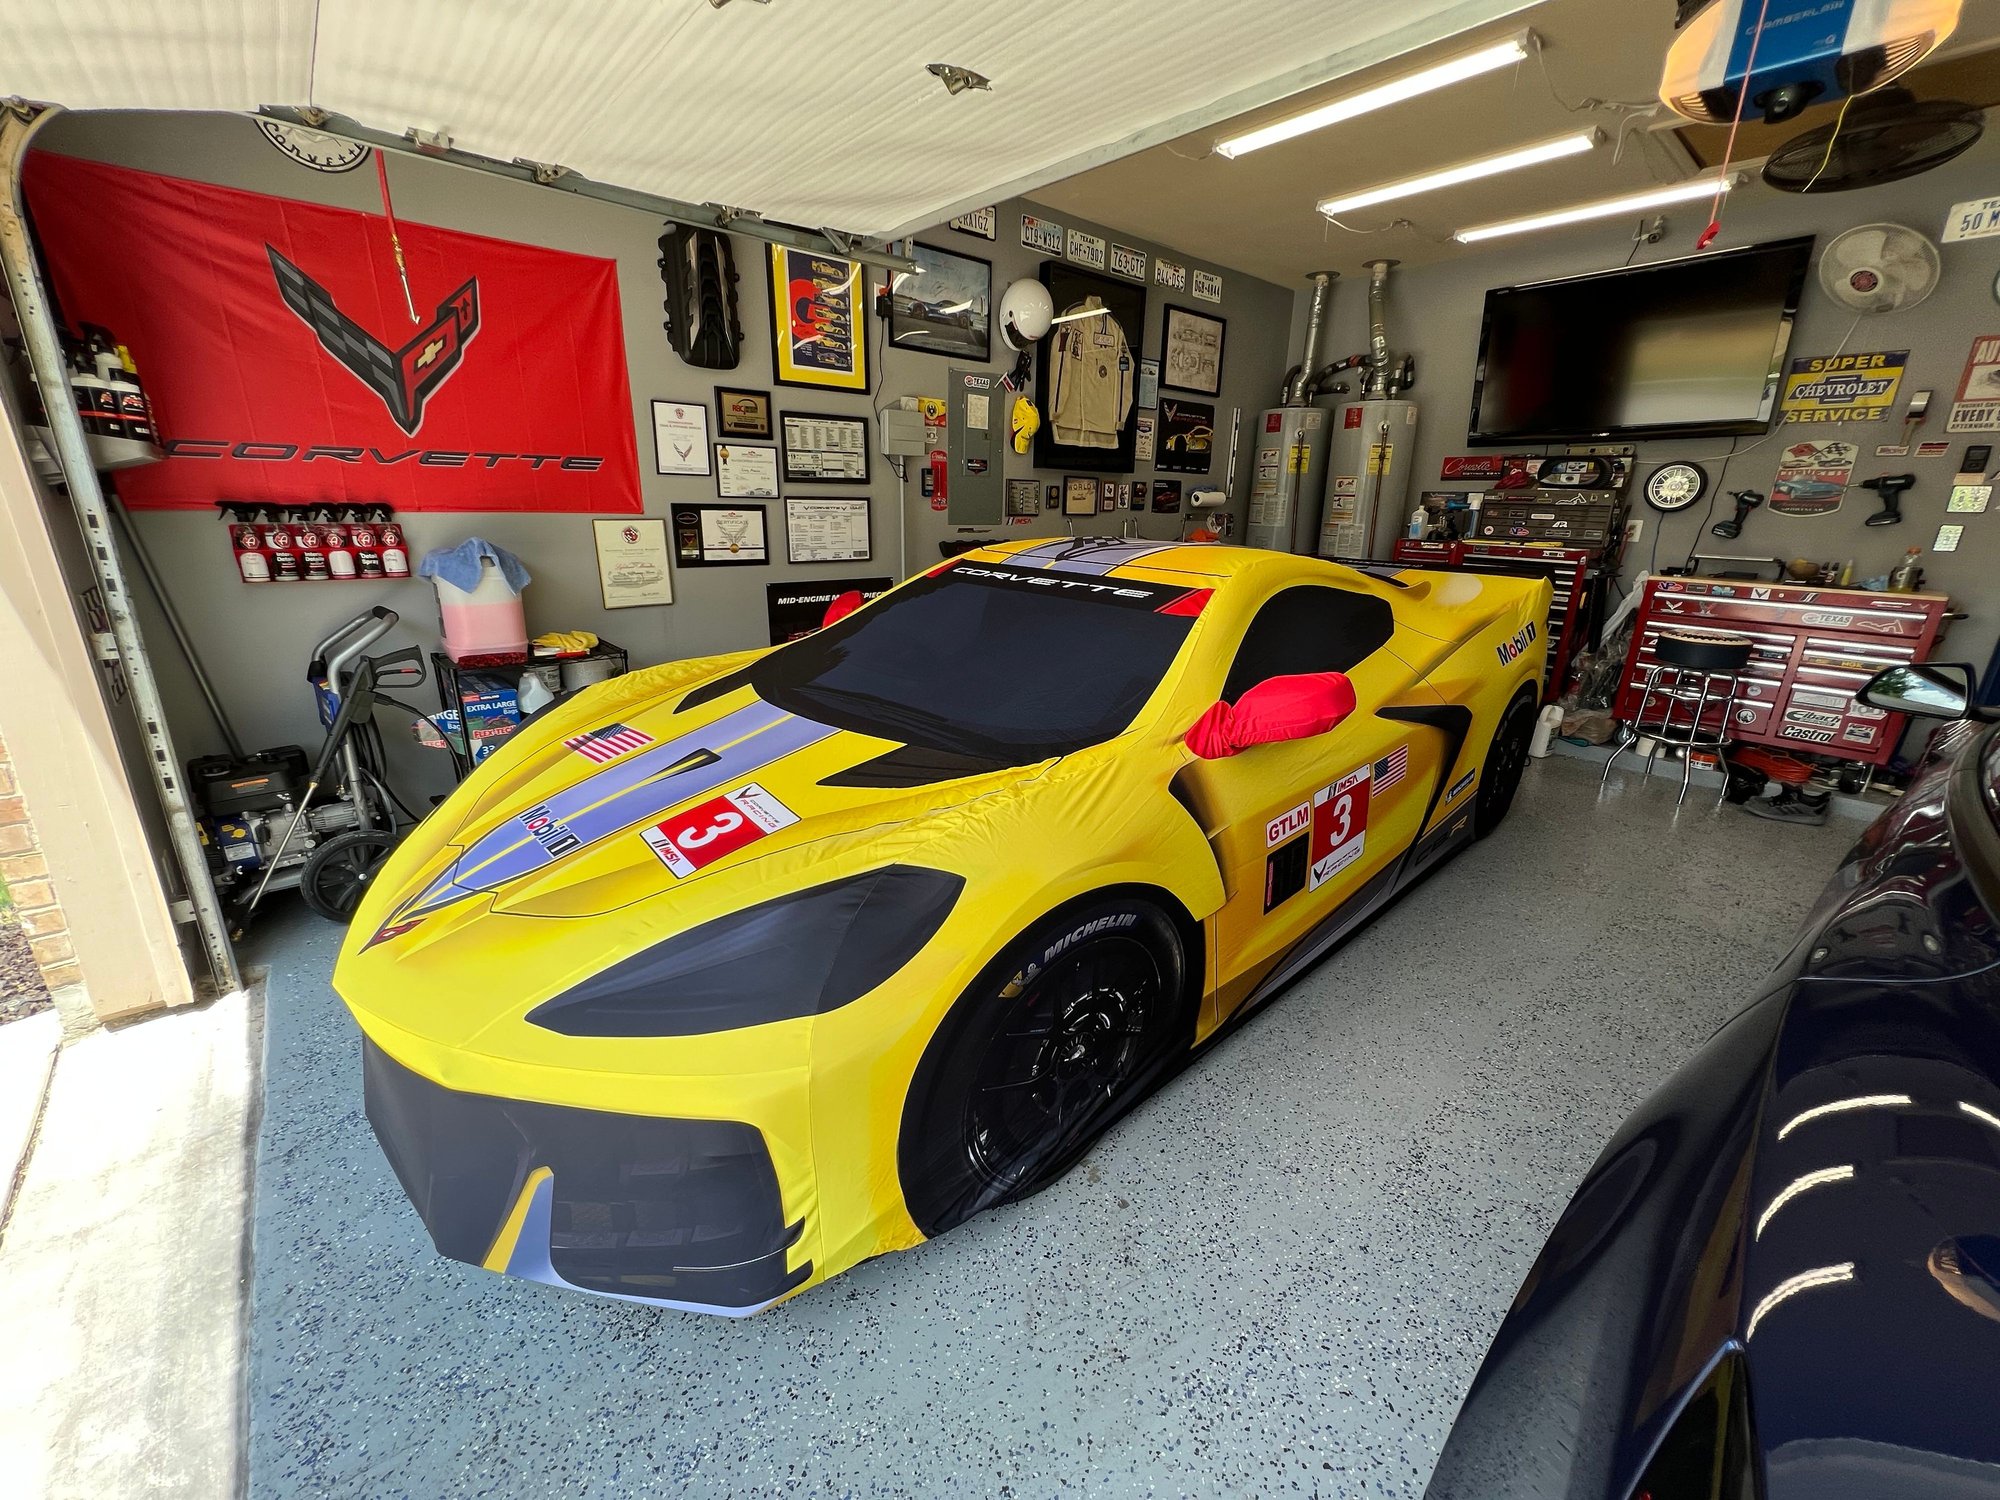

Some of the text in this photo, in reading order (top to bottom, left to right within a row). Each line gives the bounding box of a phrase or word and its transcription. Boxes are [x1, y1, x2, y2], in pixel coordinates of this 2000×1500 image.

[1960, 212, 1984, 232] 50
[1080, 235, 1095, 245] TEXAS
[1202, 274, 1214, 282] TEXAS
[1809, 355, 1886, 372] SUPER
[1795, 381, 1888, 398] CHEVROLET
[1786, 408, 1882, 423] SERVICE
[1953, 409, 1995, 422] EVERY
[167, 439, 605, 472] CORVETTE
[952, 567, 1154, 599] CORVETTE
[1820, 614, 1851, 624] TEXAS
[1496, 629, 1529, 667] Mobil
[466, 699, 517, 713] EXTRA LARGE
[1782, 725, 1837, 743] Castrol
[1337, 774, 1359, 793] IMSA
[741, 799, 778, 828] RACING
[1269, 806, 1309, 841] GTLM
[1330, 794, 1353, 846] 3
[518, 804, 570, 844] Mobil
[677, 812, 744, 849] 3
[659, 846, 681, 866] IMSA
[1043, 913, 1137, 964] MICHELIN
